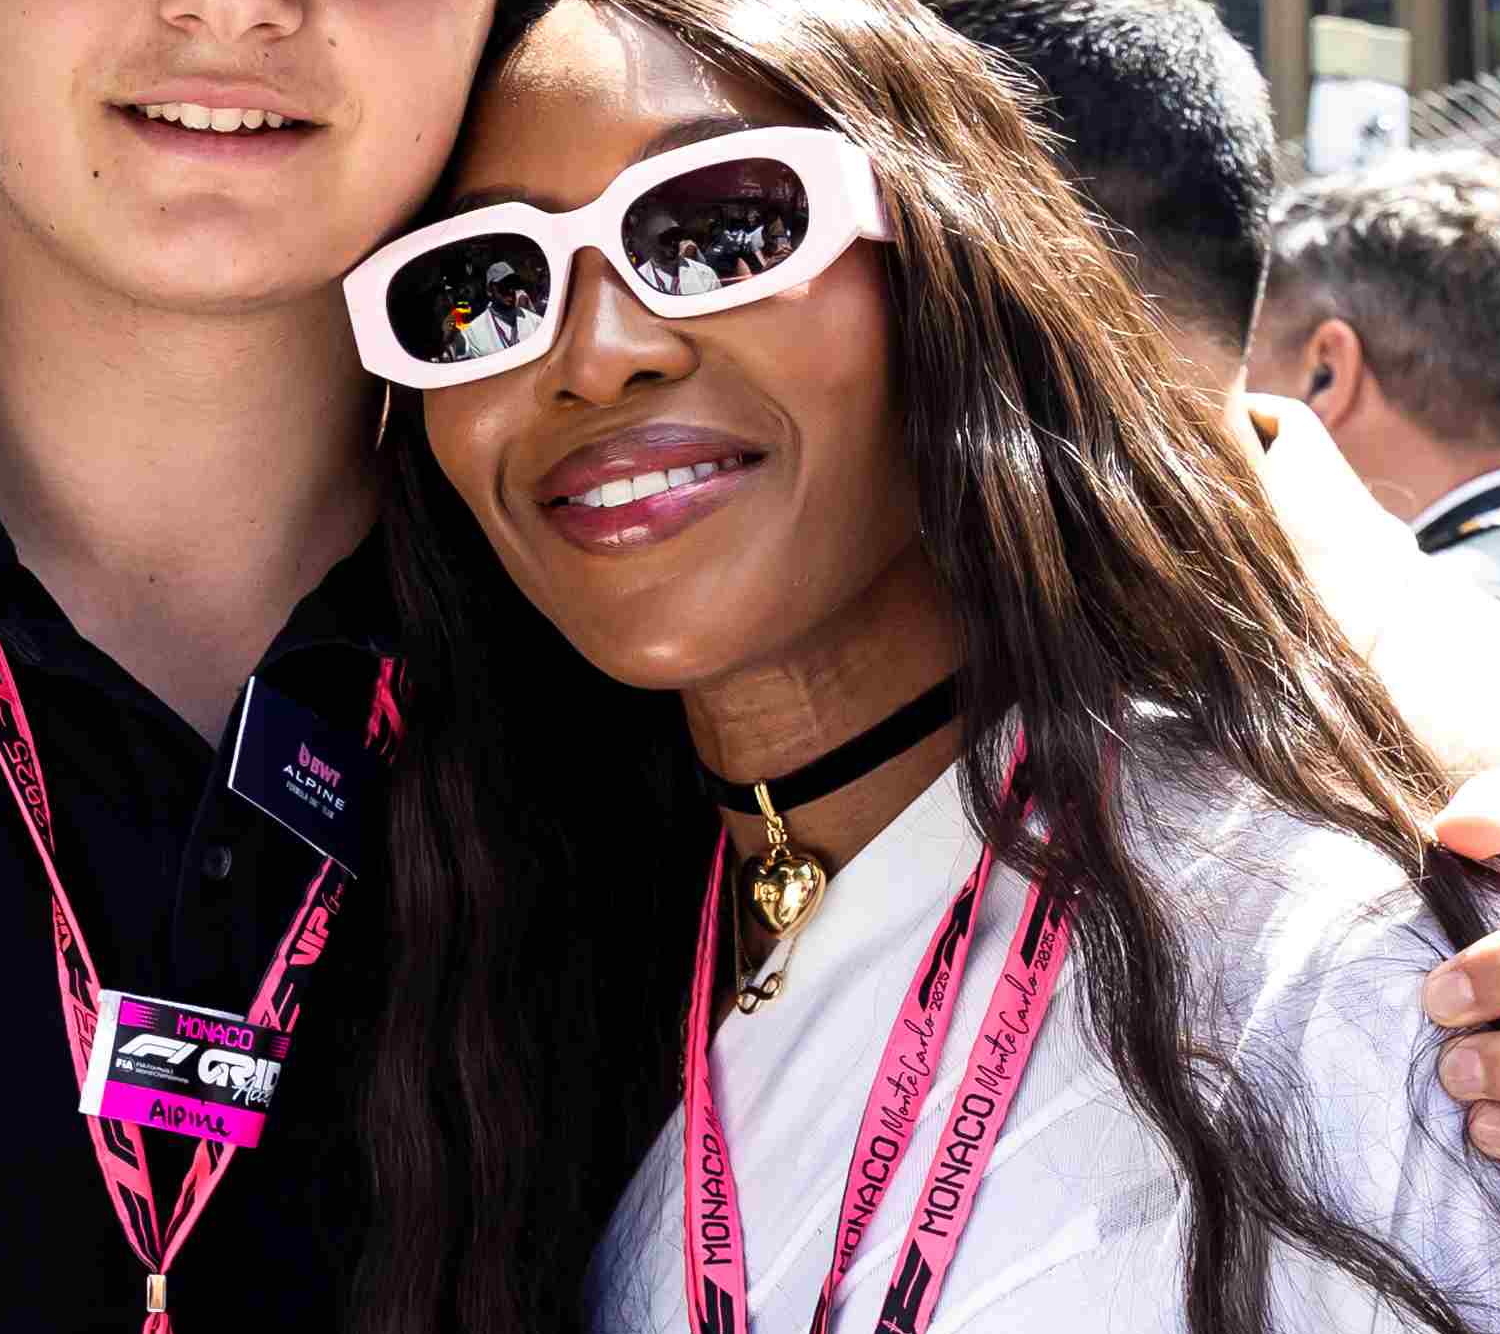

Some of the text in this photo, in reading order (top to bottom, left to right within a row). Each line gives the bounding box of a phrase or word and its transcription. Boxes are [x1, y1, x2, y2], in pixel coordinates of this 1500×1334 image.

[282, 763, 346, 812] ALPINE
[309, 754, 343, 789] BWT
[289, 906, 330, 967] VIP
[116, 1032, 200, 1065] F1
[175, 1013, 255, 1051] MONACO
[880, 1072, 920, 1139] Monte
[900, 1012, 936, 1079] Carlo
[929, 970, 951, 1012] 2025
[917, 929, 1057, 1237] MONACO Monte Carlo 2025
[149, 1099, 233, 1138] Alpine
[702, 1130, 733, 1268] MONACO
